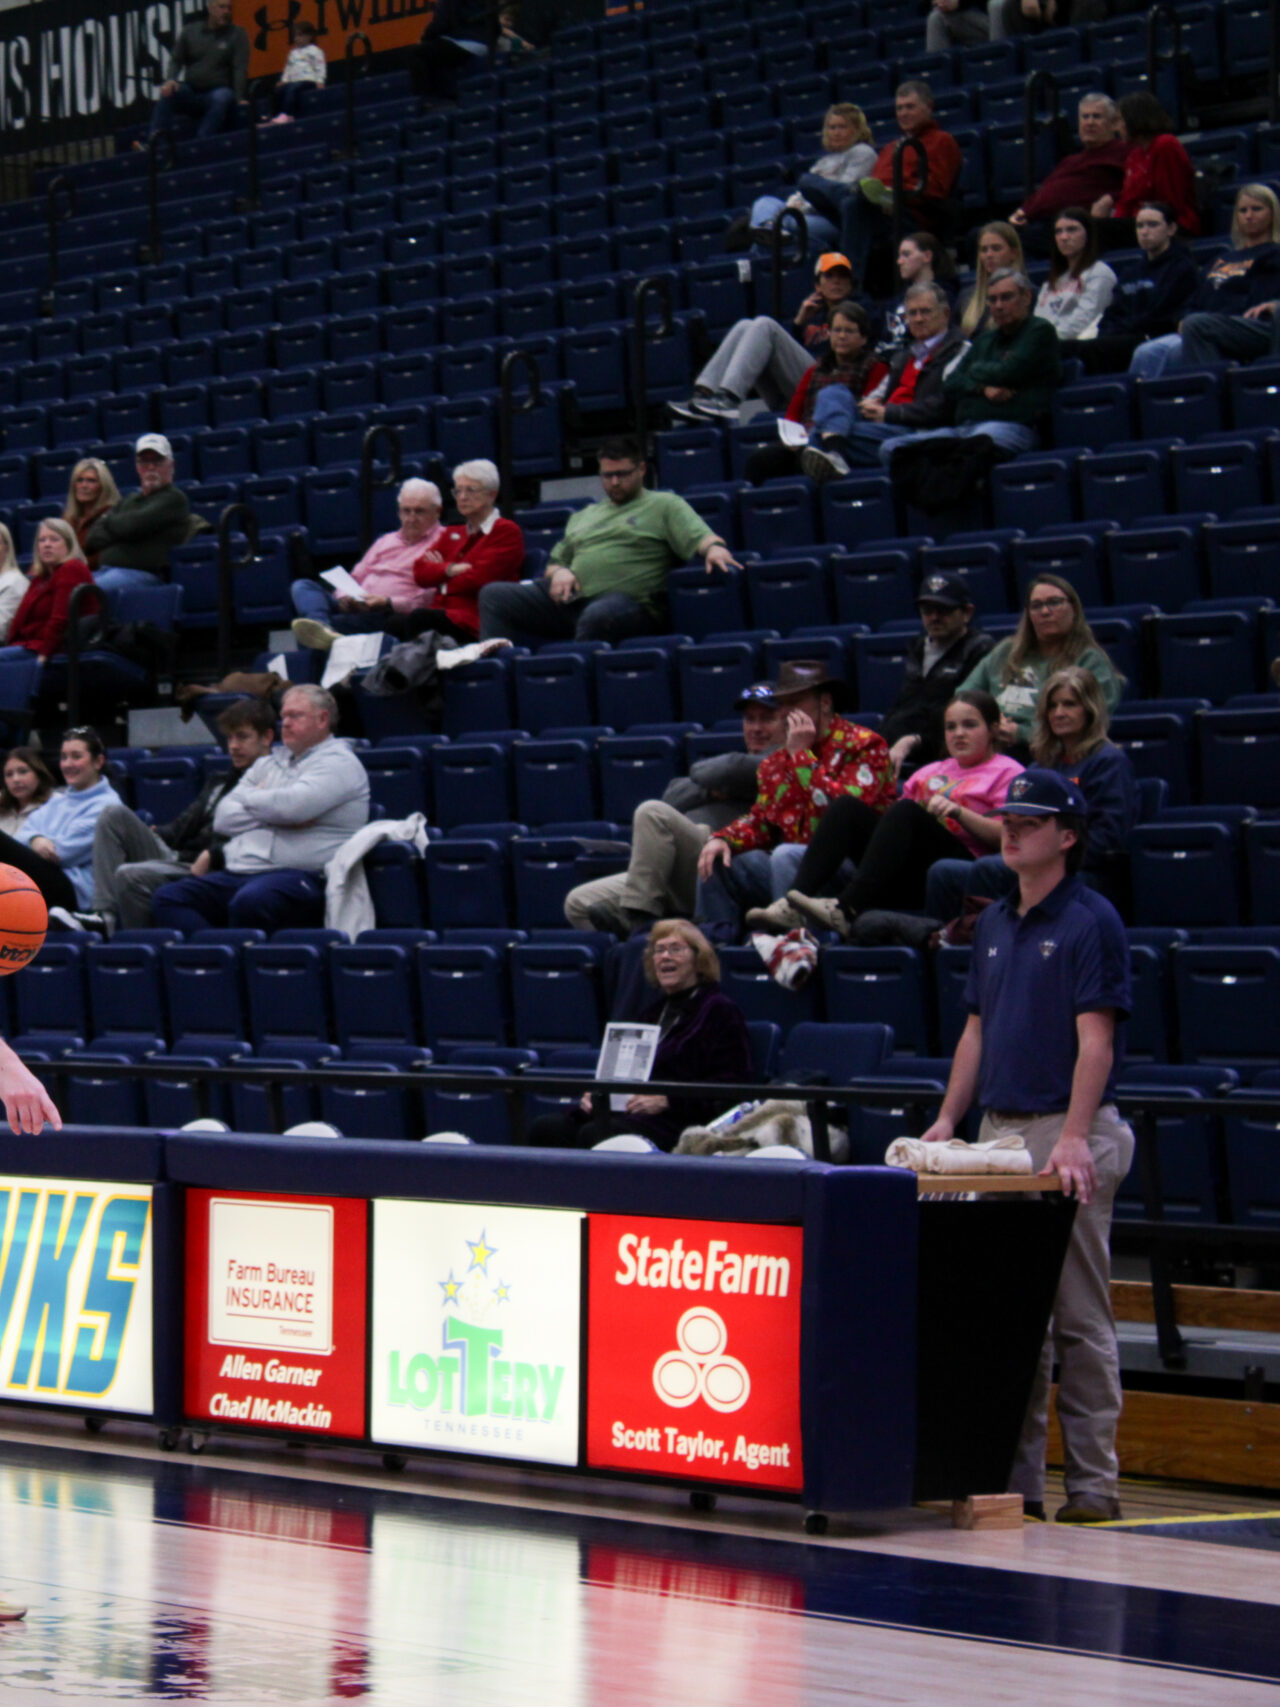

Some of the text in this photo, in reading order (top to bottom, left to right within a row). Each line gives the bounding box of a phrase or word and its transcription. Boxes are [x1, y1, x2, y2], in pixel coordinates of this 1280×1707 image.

[227, 1259, 315, 1286] Farm Bureau
[226, 1286, 314, 1314] INSURANCE
[219, 1354, 322, 1387] Allen Garner
[387, 1314, 566, 1424] LOTTERY
[209, 1393, 332, 1429] Chad McMackin
[424, 1419, 524, 1440] TENNESSEE
[611, 1421, 791, 1470] Scott Taylor, Agent
